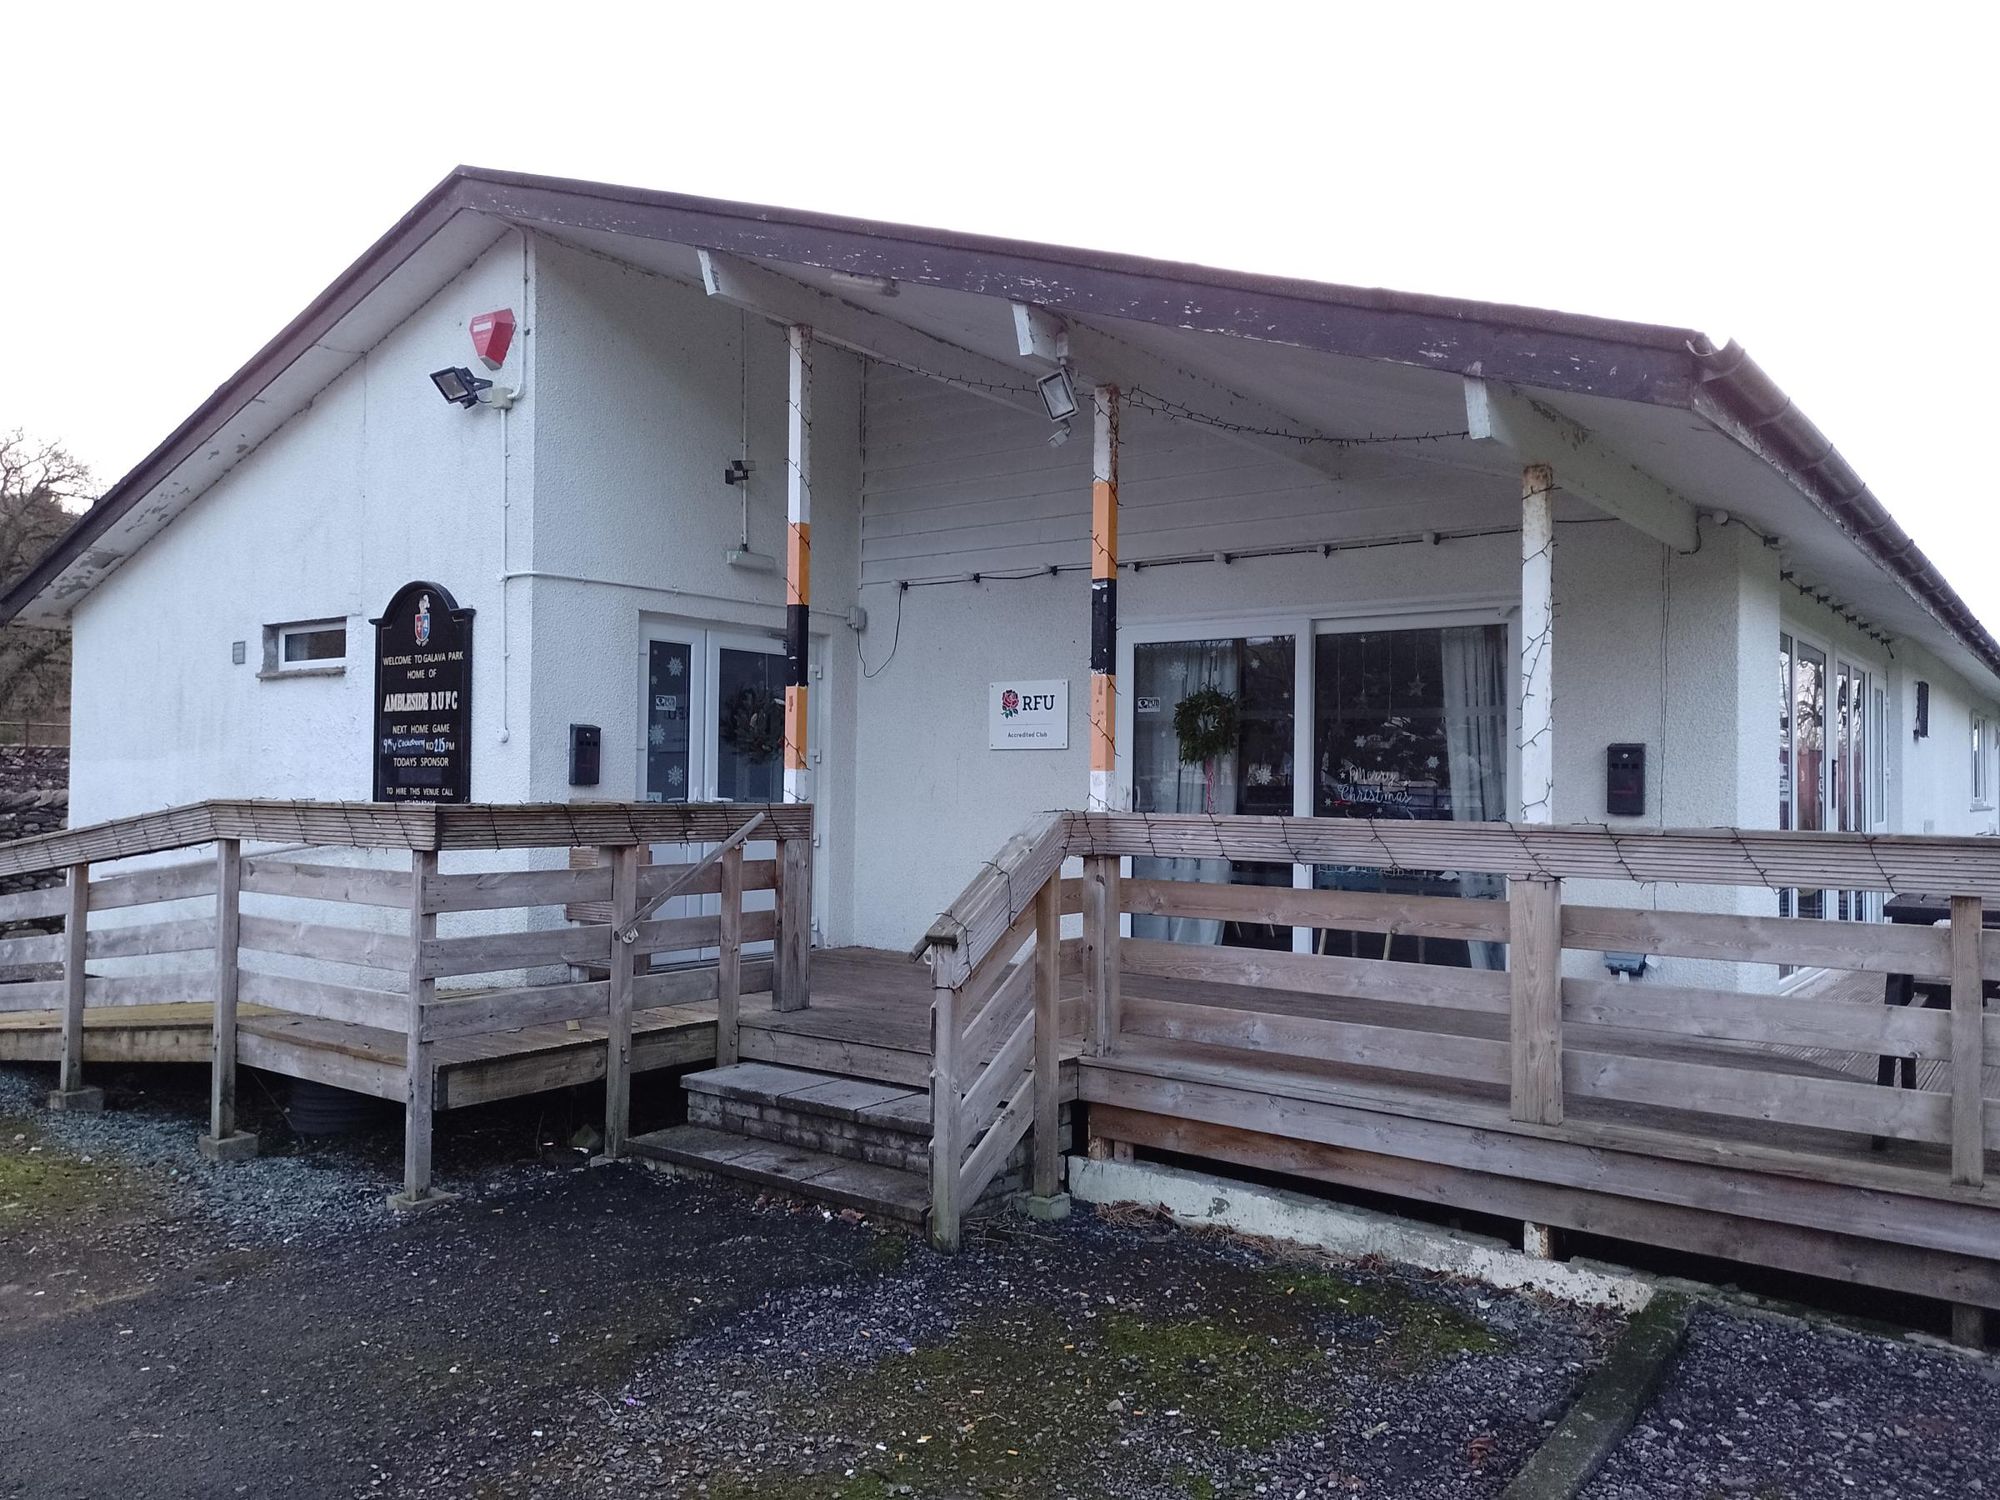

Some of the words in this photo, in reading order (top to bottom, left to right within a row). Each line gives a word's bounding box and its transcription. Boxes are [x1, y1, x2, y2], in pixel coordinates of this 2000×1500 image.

[383, 655, 412, 666] WELCOME
[414, 654, 422, 664] TO
[423, 652, 446, 662] GALAVA
[448, 651, 464, 660] PARK
[407, 670, 425, 679] HOME
[428, 668, 437, 678] OF
[384, 692, 428, 712] AMBLESIDE
[430, 691, 458, 711] RUFC
[1022, 694, 1055, 710] RFU
[392, 725, 408, 734] NEXT
[410, 724, 428, 734] HOME
[432, 724, 450, 733] GAME
[426, 742, 434, 750] KO
[446, 742, 455, 750] PM
[394, 758, 416, 767] TODAYS
[420, 758, 449, 766] SPONSOR
[1350, 765, 1399, 786] Merry
[386, 787, 394, 795] TO
[396, 788, 407, 796] HIRE
[410, 788, 420, 796] THIS
[1338, 784, 1412, 803] Christmas
